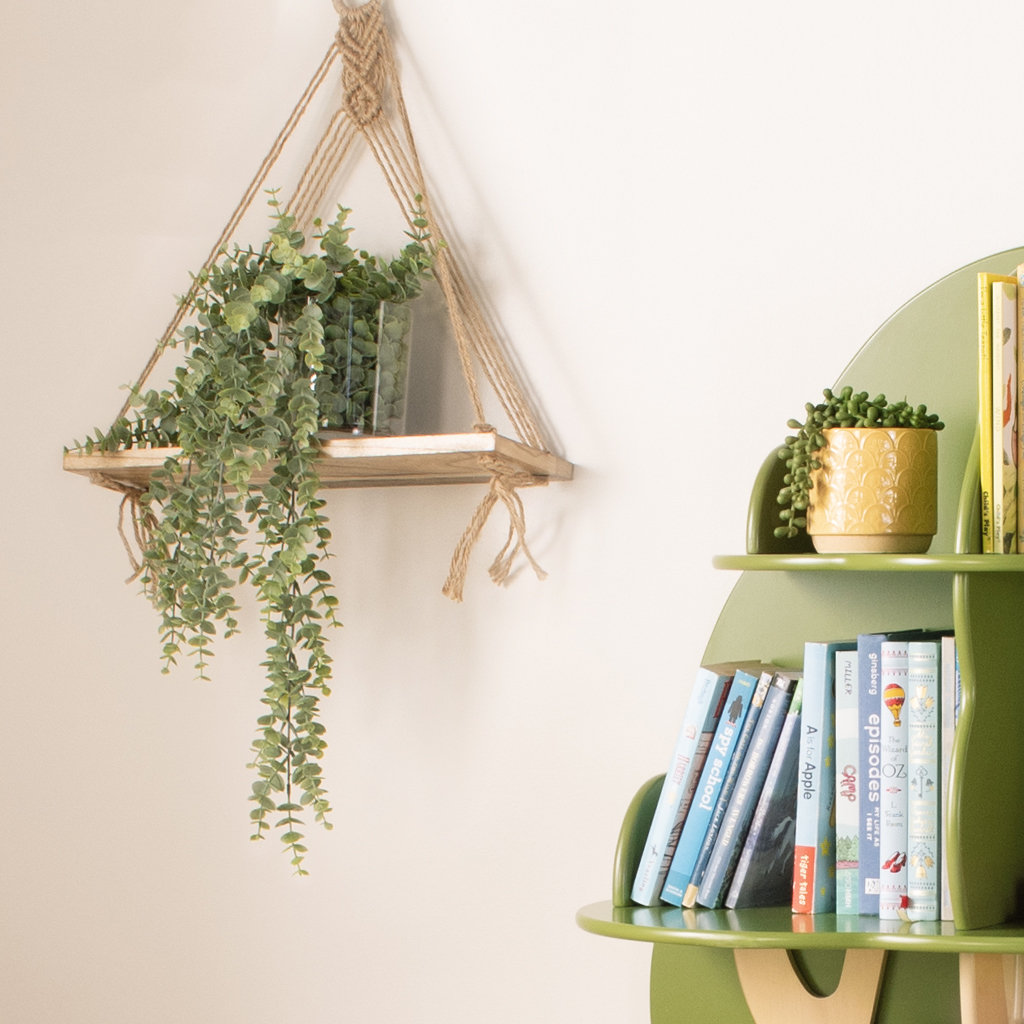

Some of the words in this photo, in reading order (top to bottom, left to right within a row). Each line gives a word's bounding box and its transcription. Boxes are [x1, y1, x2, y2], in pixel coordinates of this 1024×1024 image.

[983, 519, 991, 537] Play
[844, 660, 852, 695] MILLER
[868, 653, 879, 695] ginsberg
[714, 726, 734, 757] spy
[806, 725, 818, 735] A
[806, 747, 814, 761] for
[864, 714, 880, 802] episodes
[699, 757, 723, 812] school
[802, 762, 816, 800] Apple
[872, 819, 880, 834] LIFE
[800, 855, 809, 880] tiger
[799, 881, 808, 906] tales
